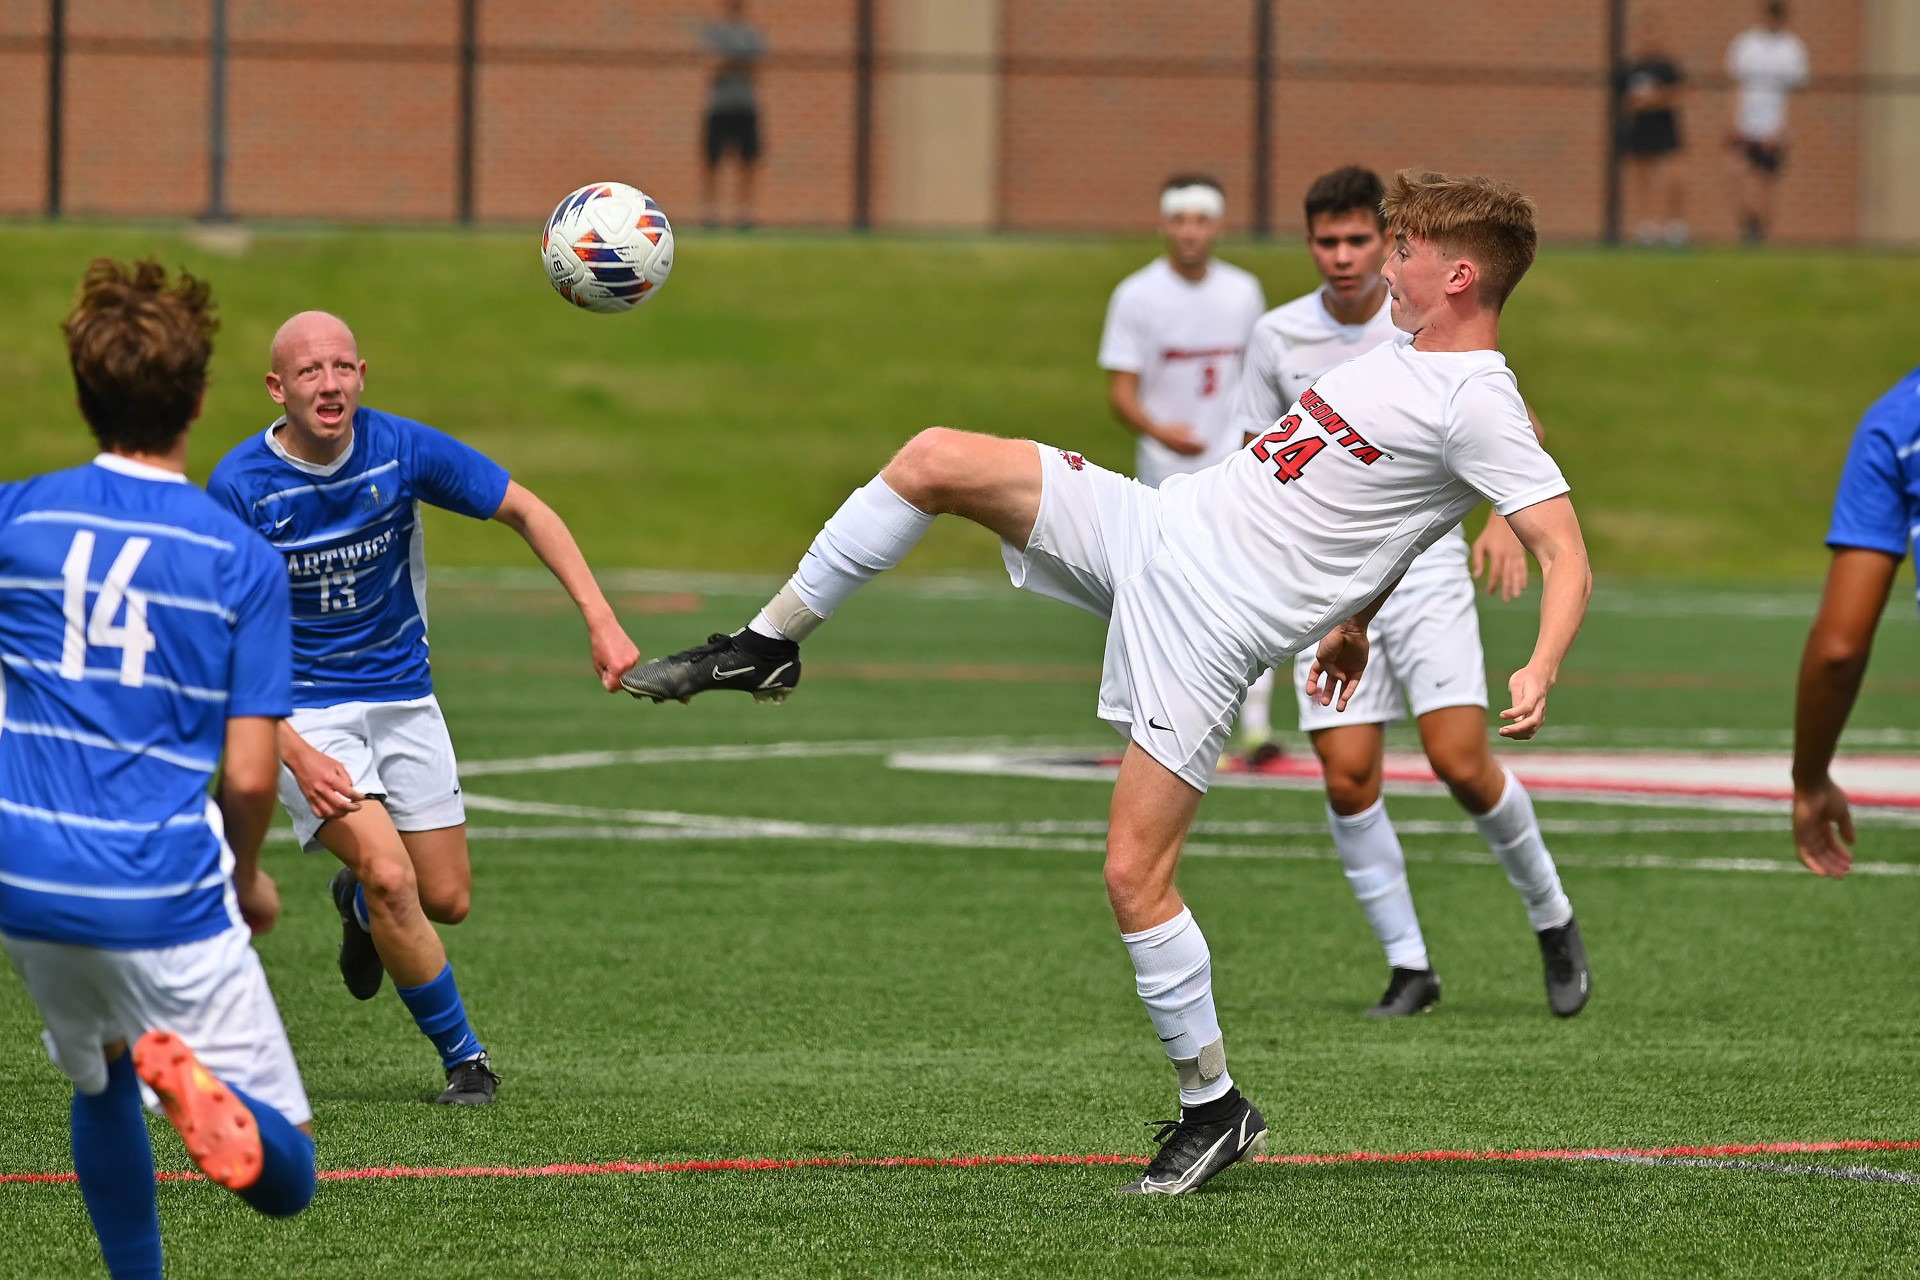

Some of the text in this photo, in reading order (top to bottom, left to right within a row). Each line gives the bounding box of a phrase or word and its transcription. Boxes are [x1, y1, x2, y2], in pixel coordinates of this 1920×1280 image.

[1250, 413, 1329, 486] 24
[58, 529, 157, 689] 14
[319, 568, 357, 614] 13
